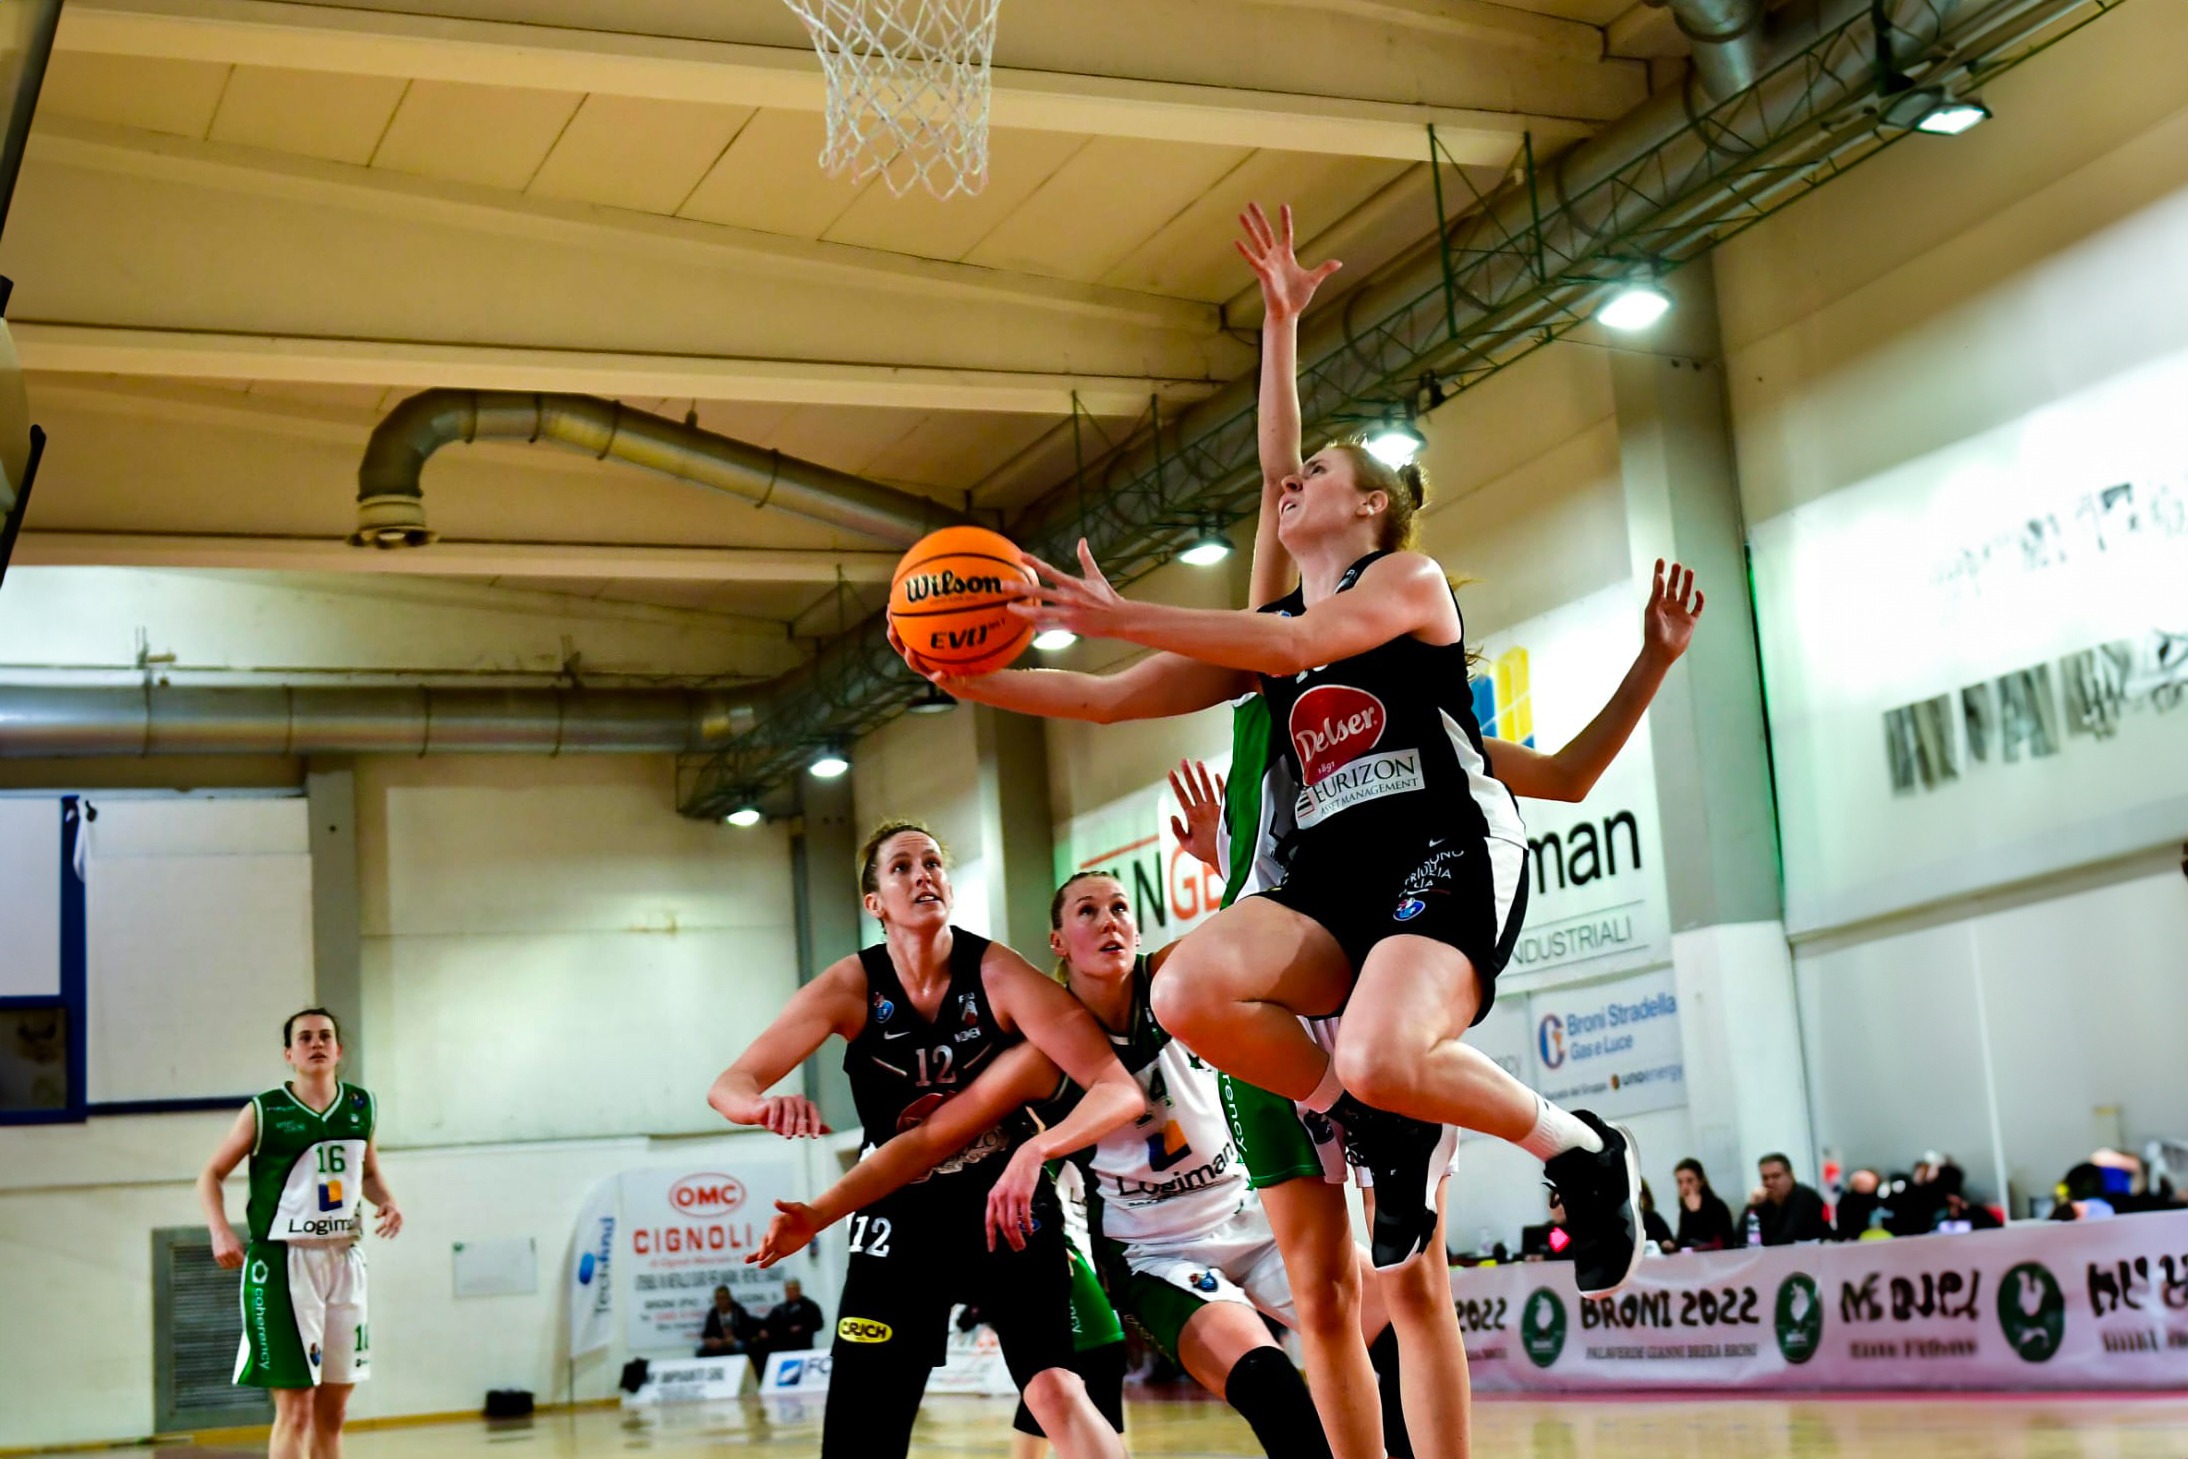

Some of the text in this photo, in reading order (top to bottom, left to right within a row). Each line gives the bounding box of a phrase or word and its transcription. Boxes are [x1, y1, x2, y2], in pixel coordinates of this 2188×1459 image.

[906, 569, 1002, 603] Wilson
[1295, 706, 1376, 763] Delser
[1311, 756, 1415, 803] EURIZON
[1341, 777, 1418, 805] MANAGEMENT
[1567, 992, 1677, 1037] Broni Stradella
[1604, 1035, 1633, 1053] Luce
[915, 1044, 957, 1087] 12
[316, 1145, 346, 1173] 16
[676, 1184, 737, 1207] OMC
[288, 1217, 354, 1236] Logim
[633, 1223, 753, 1255] CIGNOLI
[850, 1215, 892, 1258] 12
[1580, 1286, 1760, 1330] BRONI 2022
[254, 1287, 271, 1371] coherency
[354, 1325, 370, 1352] 1
